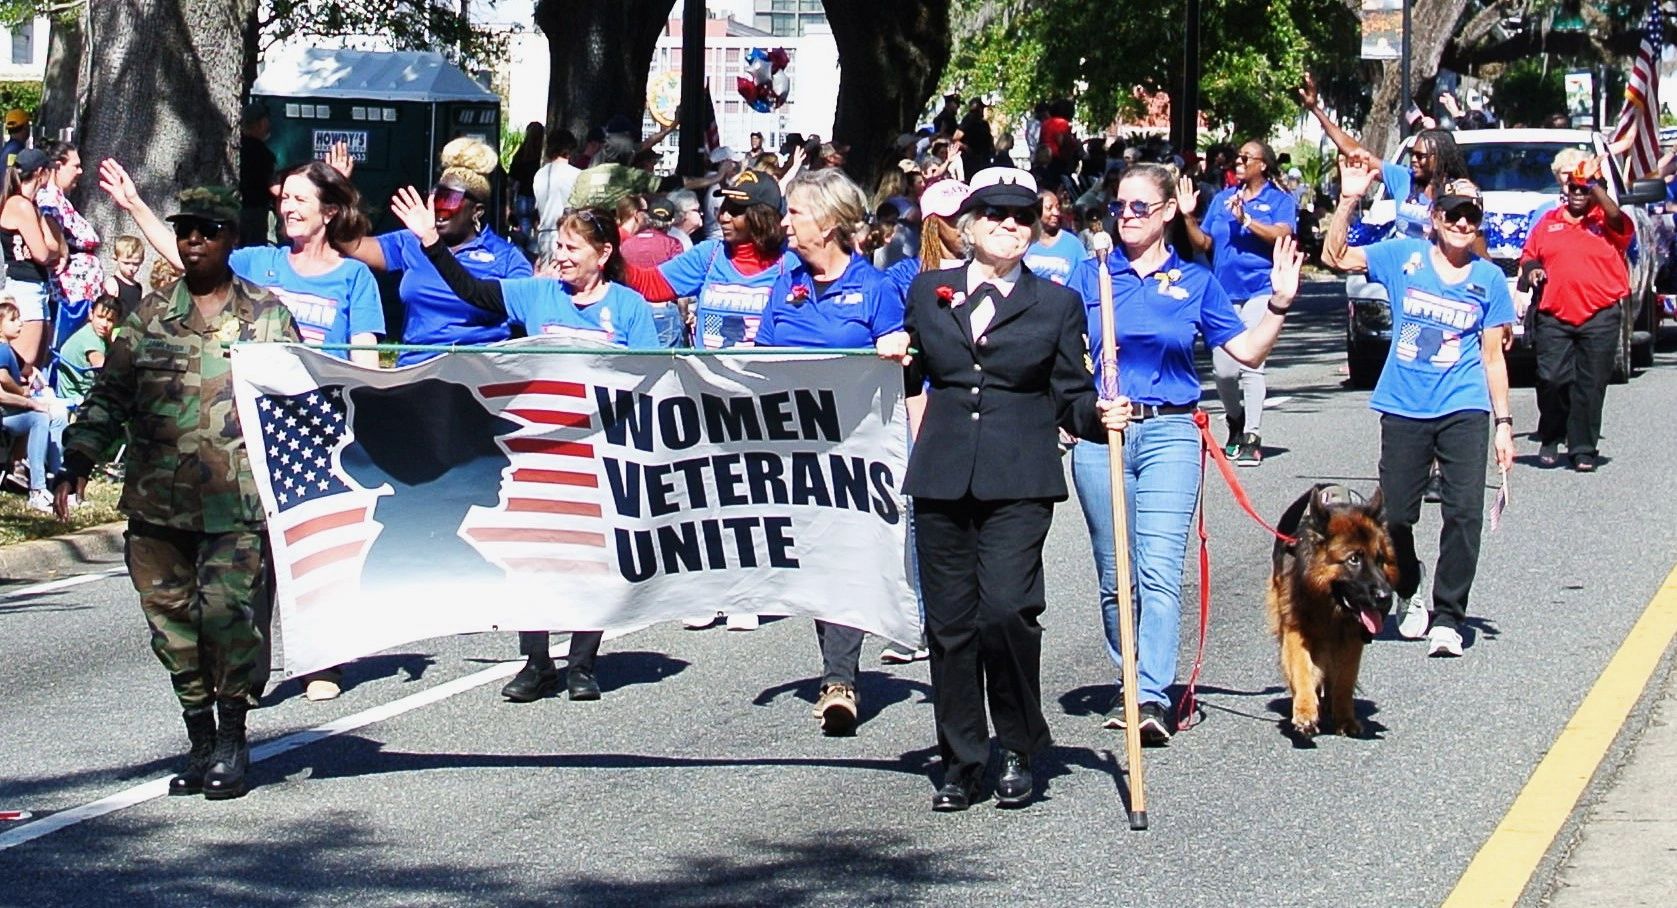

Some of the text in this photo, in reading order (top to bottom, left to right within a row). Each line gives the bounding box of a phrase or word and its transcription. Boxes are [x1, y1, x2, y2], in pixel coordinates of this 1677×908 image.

[316, 132, 365, 146] HOWDY'S
[1402, 296, 1477, 331] VETERAN
[594, 386, 841, 452] WOMEN
[603, 452, 900, 525] VETERANS
[614, 517, 800, 583] UNITE
